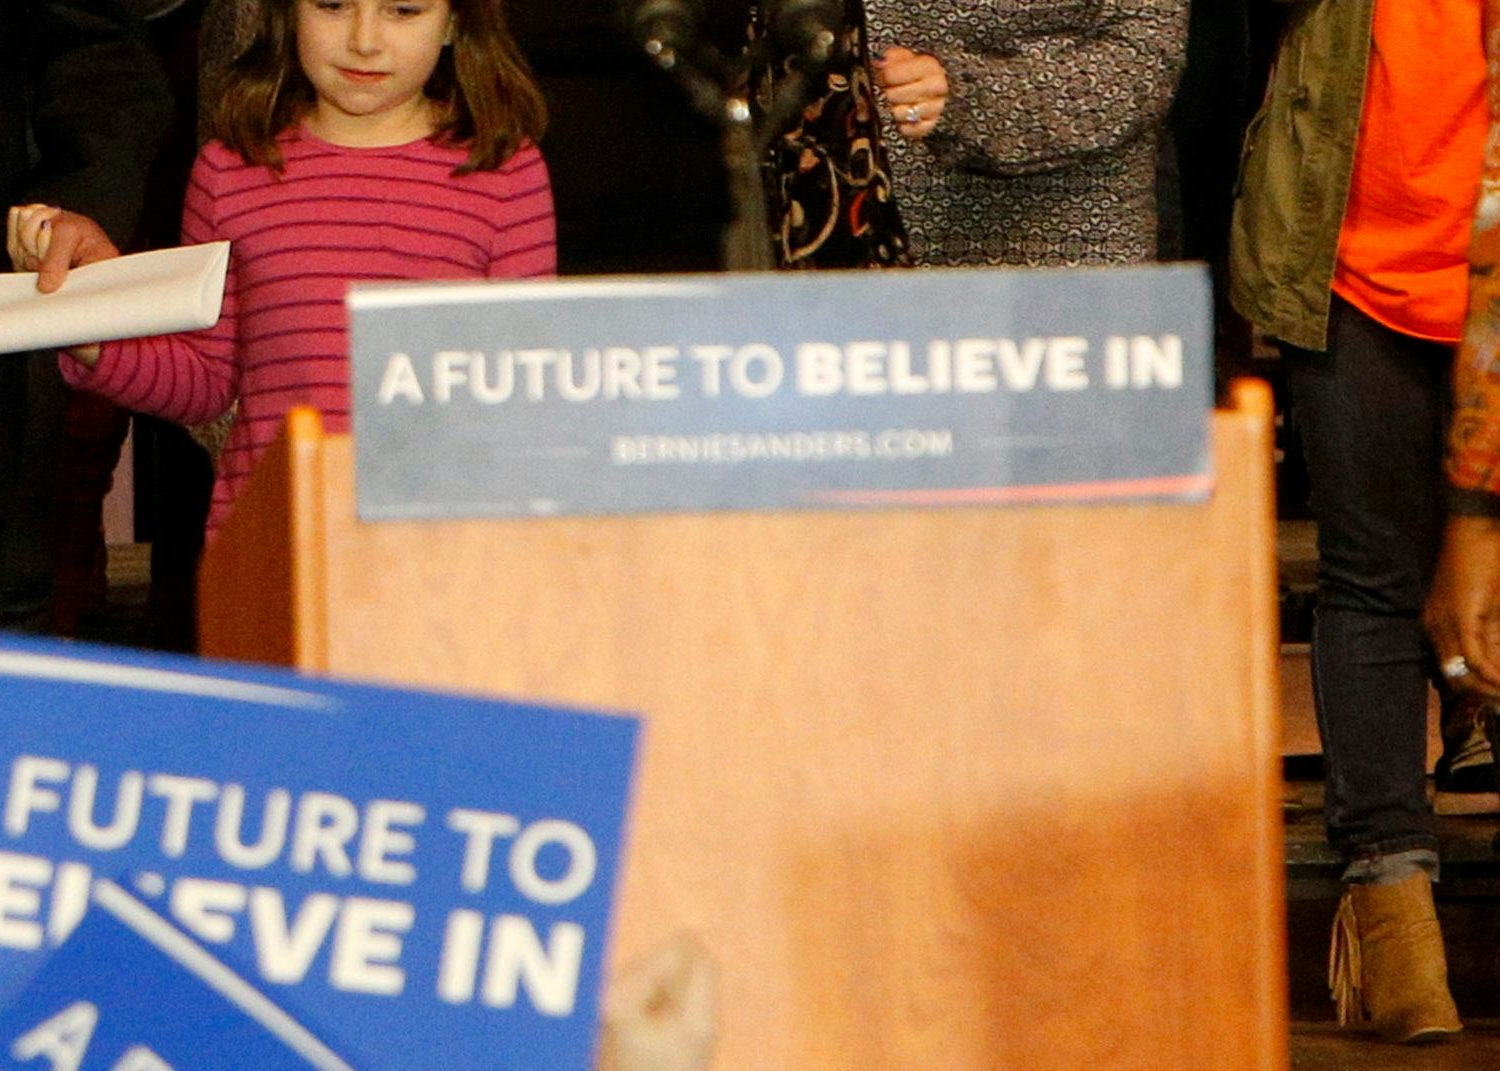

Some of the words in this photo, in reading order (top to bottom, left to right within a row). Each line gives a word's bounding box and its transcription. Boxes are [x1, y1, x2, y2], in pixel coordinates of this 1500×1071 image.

[376, 353, 425, 405] A
[432, 345, 681, 405] FUTURE
[691, 343, 785, 400] TO
[796, 337, 1090, 396] BELIEVE
[1105, 334, 1183, 389] IN
[610, 430, 955, 465] BERNIESANDERS.COM
[3, 754, 427, 886] FUTURE
[446, 807, 598, 905] TO
[434, 909, 586, 1019] IN
[11, 1000, 99, 1071] A
